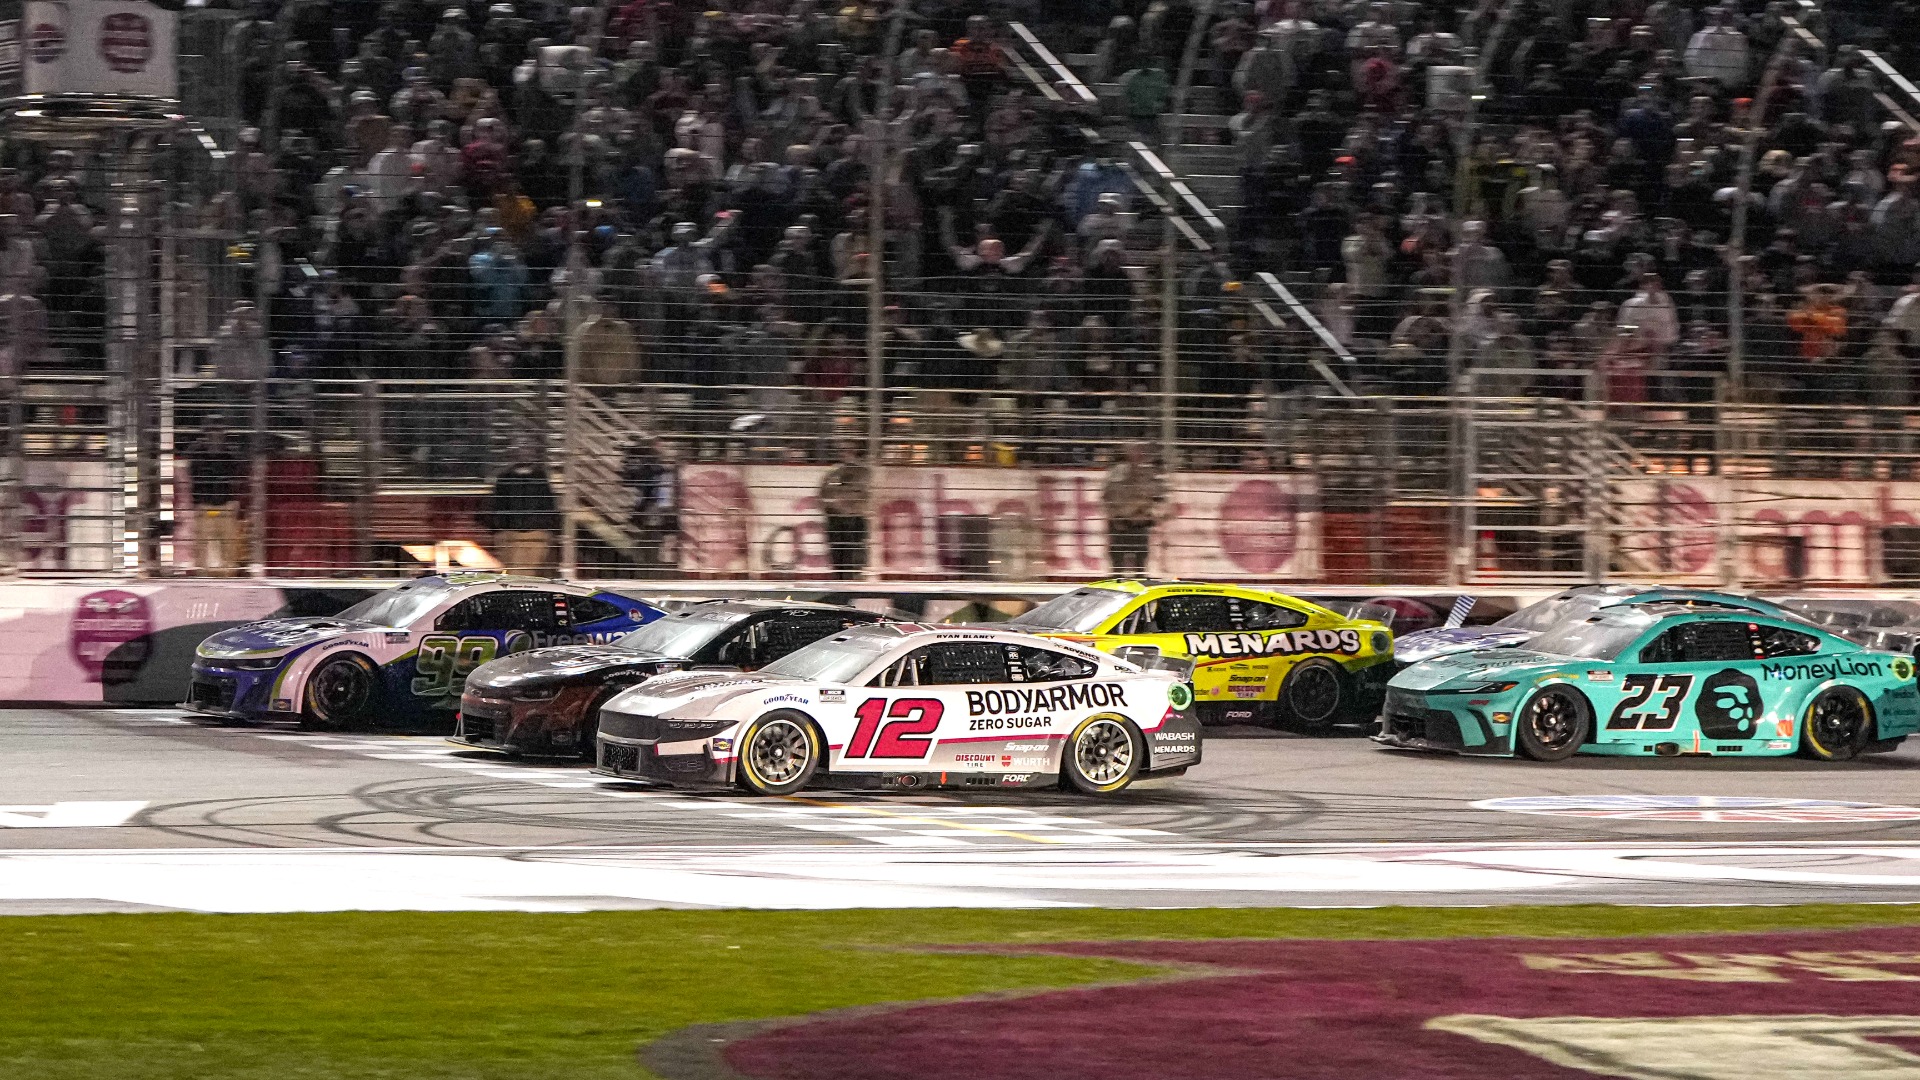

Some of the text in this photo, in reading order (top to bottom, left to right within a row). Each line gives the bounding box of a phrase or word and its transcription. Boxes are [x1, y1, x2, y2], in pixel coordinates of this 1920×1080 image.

[322, 639, 370, 651] GOODYEAR
[532, 630, 635, 648] Freew
[1185, 629, 1361, 658] MENARDS
[411, 635, 498, 697] 99
[1760, 657, 1883, 682] MoneyLion
[1229, 674, 1266, 683] Snap-on
[763, 693, 809, 705] GOODYEAR
[965, 683, 1128, 716] BODYARMOR
[1605, 673, 1695, 732] 23
[844, 697, 944, 759] 12
[969, 716, 1052, 731] ZERO SUGAR
[1154, 732, 1195, 741] WABASH
[1004, 742, 1050, 753] Snap-on
[1154, 745, 1195, 754] MENARDS
[955, 754, 996, 762] DISCOUNT
